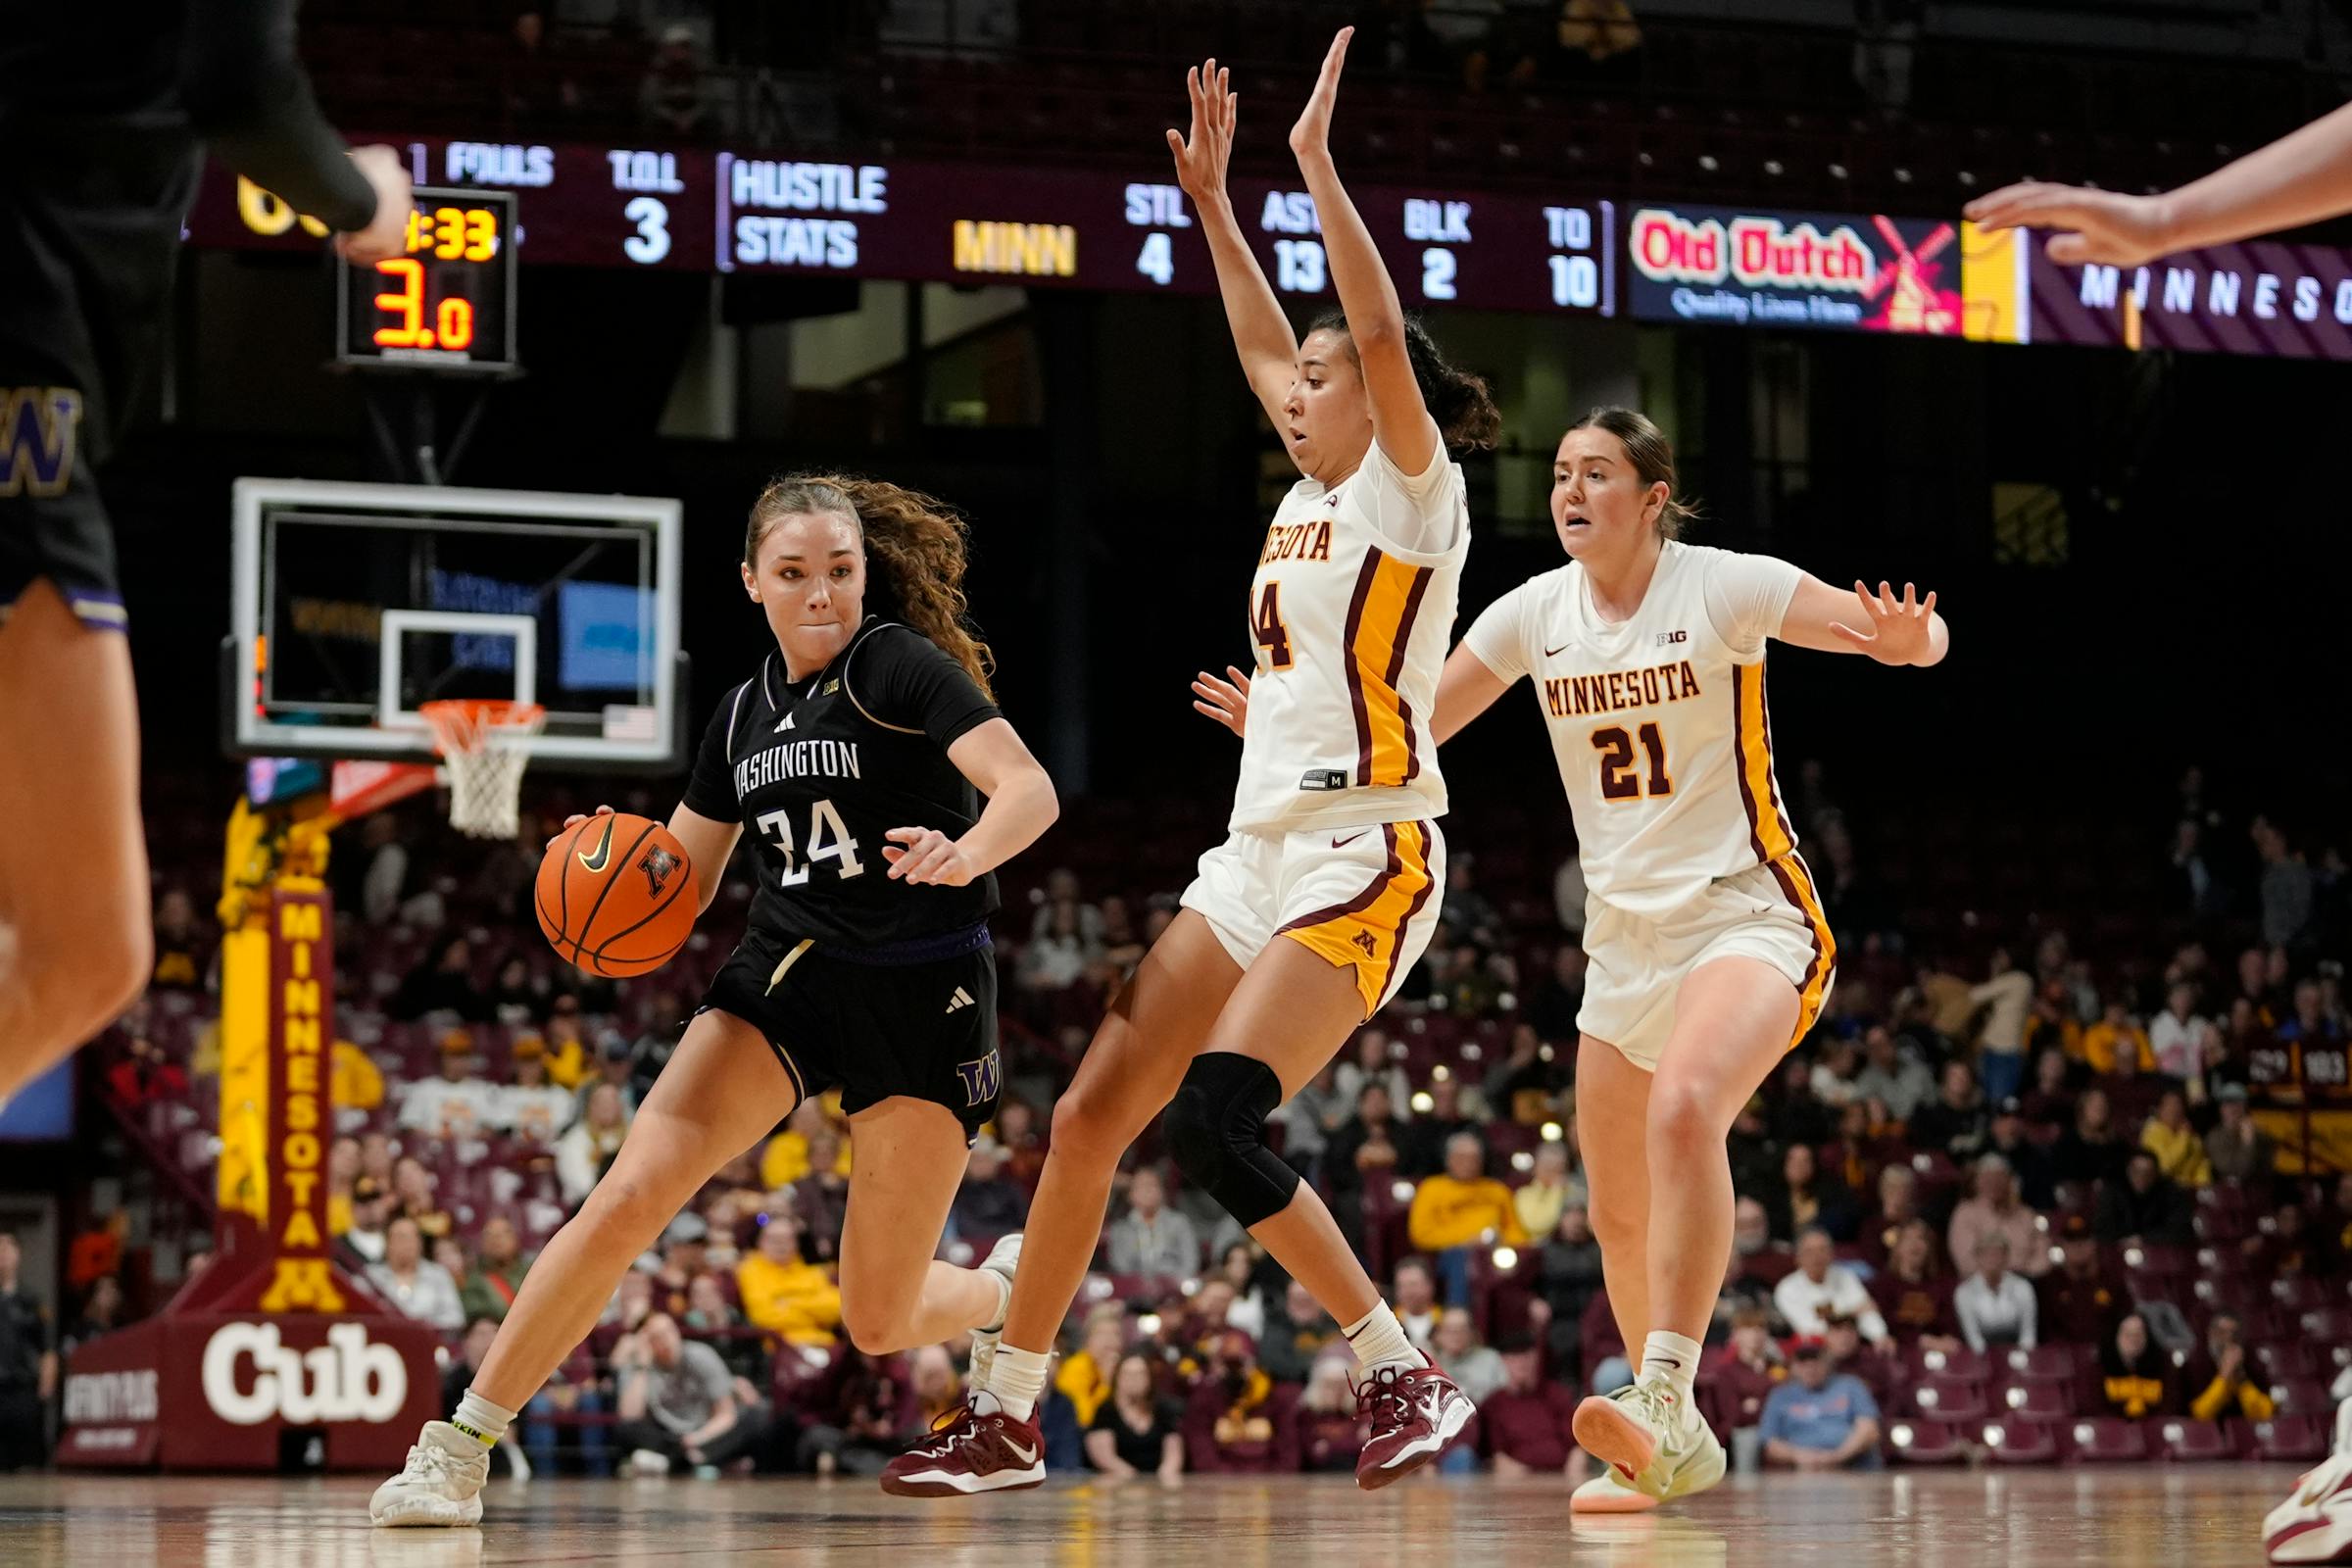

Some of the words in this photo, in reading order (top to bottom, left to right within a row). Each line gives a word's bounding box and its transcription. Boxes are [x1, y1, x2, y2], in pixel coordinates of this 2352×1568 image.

[446, 141, 554, 187] FOULS
[732, 159, 888, 214] HUSTLE
[624, 197, 671, 264] 3
[1126, 183, 1192, 227] STL
[1403, 198, 1471, 243] BLK
[1543, 206, 1591, 250] TO
[736, 216, 858, 268] STATS
[954, 220, 1076, 276] MINN
[1137, 232, 1174, 285] 4
[1274, 239, 1326, 292] 13
[1634, 213, 1725, 281] Old
[1733, 220, 1870, 288] Dutch
[1422, 247, 1456, 300] 2
[1548, 255, 1597, 308] 10
[373, 259, 473, 351] 3.0
[1544, 660, 1700, 716] MINNESOTA
[1331, 775, 1341, 787] M
[1590, 720, 1674, 804] 21
[281, 903, 321, 1250] MINNESOTA
[956, 1048, 999, 1107] W
[202, 1322, 408, 1423] Cub
